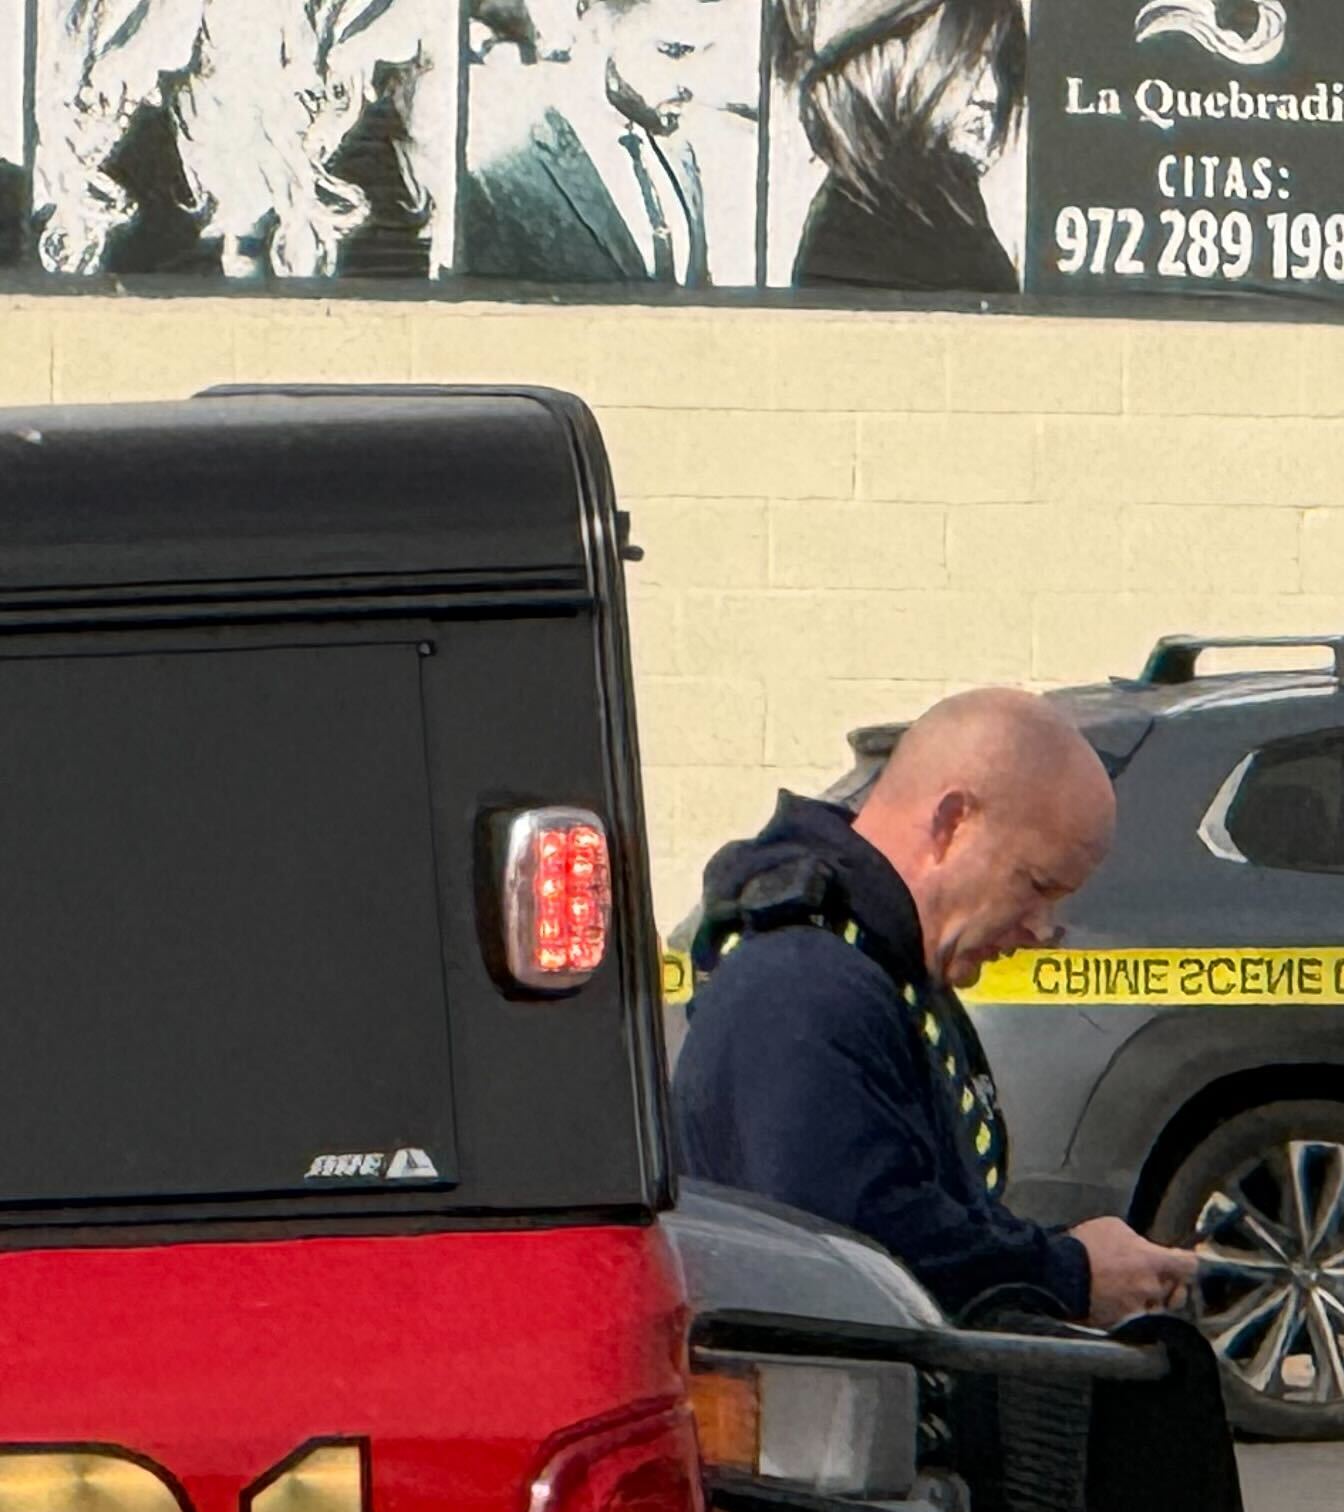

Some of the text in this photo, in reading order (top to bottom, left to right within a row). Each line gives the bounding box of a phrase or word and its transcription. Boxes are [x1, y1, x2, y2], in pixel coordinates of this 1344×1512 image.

[1064, 76, 1121, 115] La
[1158, 153, 1290, 200] CITAS:
[1055, 205, 1145, 274] 972
[1157, 208, 1253, 279] 289
